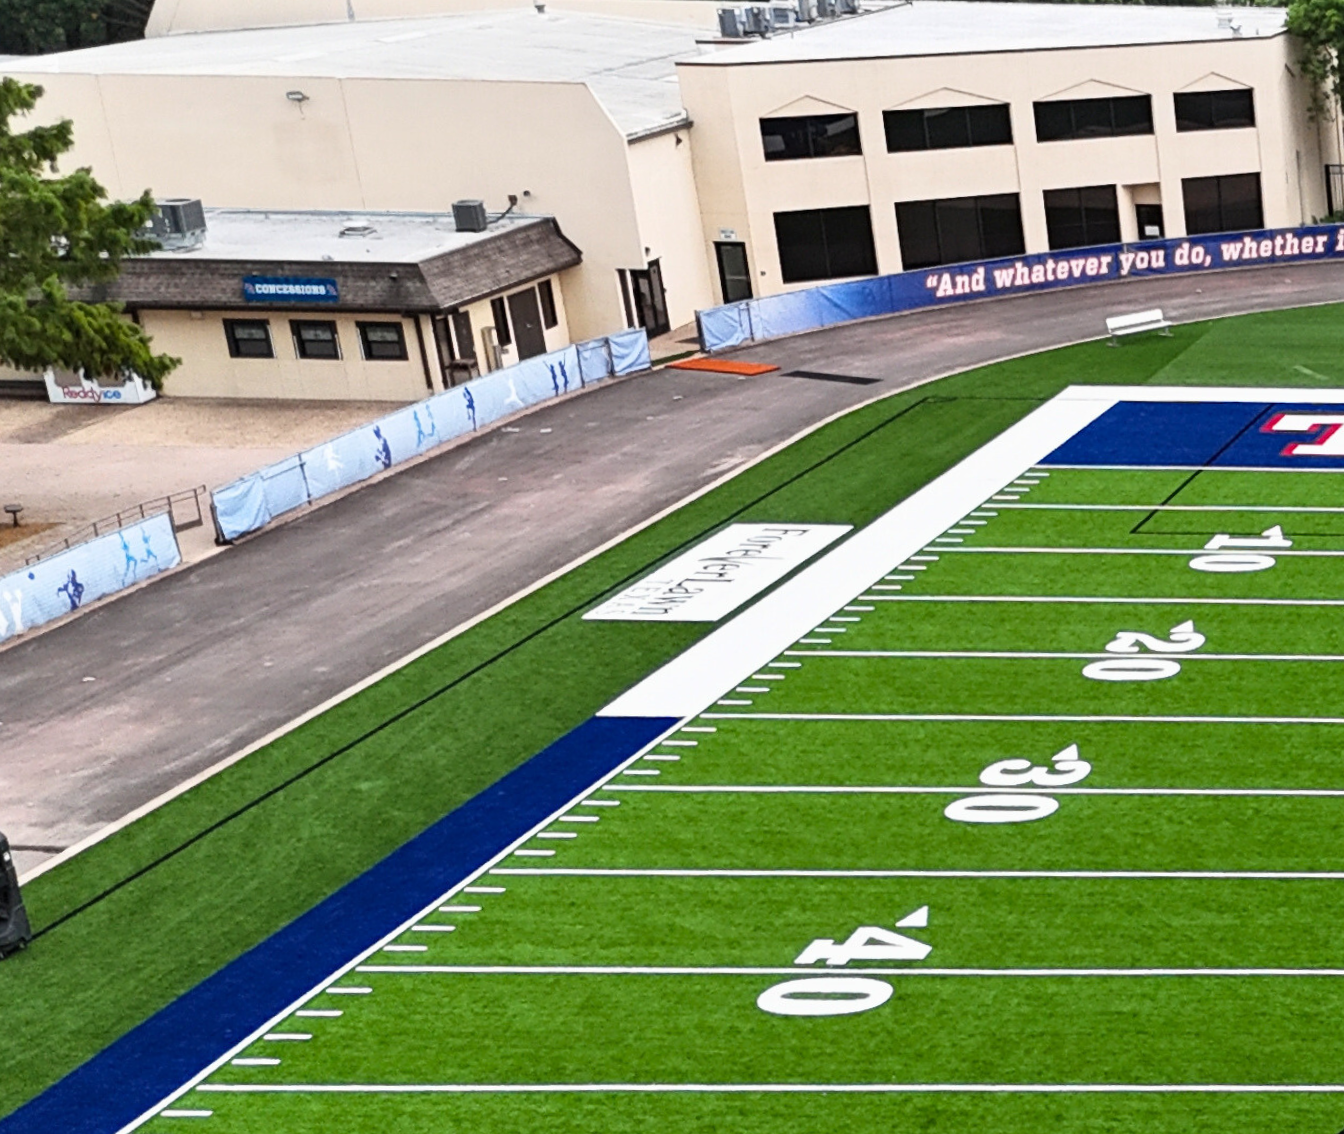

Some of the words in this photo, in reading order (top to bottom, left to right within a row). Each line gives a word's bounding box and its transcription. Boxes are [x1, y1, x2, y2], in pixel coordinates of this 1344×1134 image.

[994, 255, 1111, 288] whatever
[1119, 249, 1165, 276] you
[1174, 242, 1211, 267] do,
[1221, 232, 1328, 261] whether
[254, 283, 326, 296] CONCESSIONS
[1188, 533, 1294, 573] 10
[594, 578, 676, 616] TEXAS
[1081, 630, 1206, 682] 20
[943, 758, 1092, 824] 30
[756, 925, 933, 1017] 40
